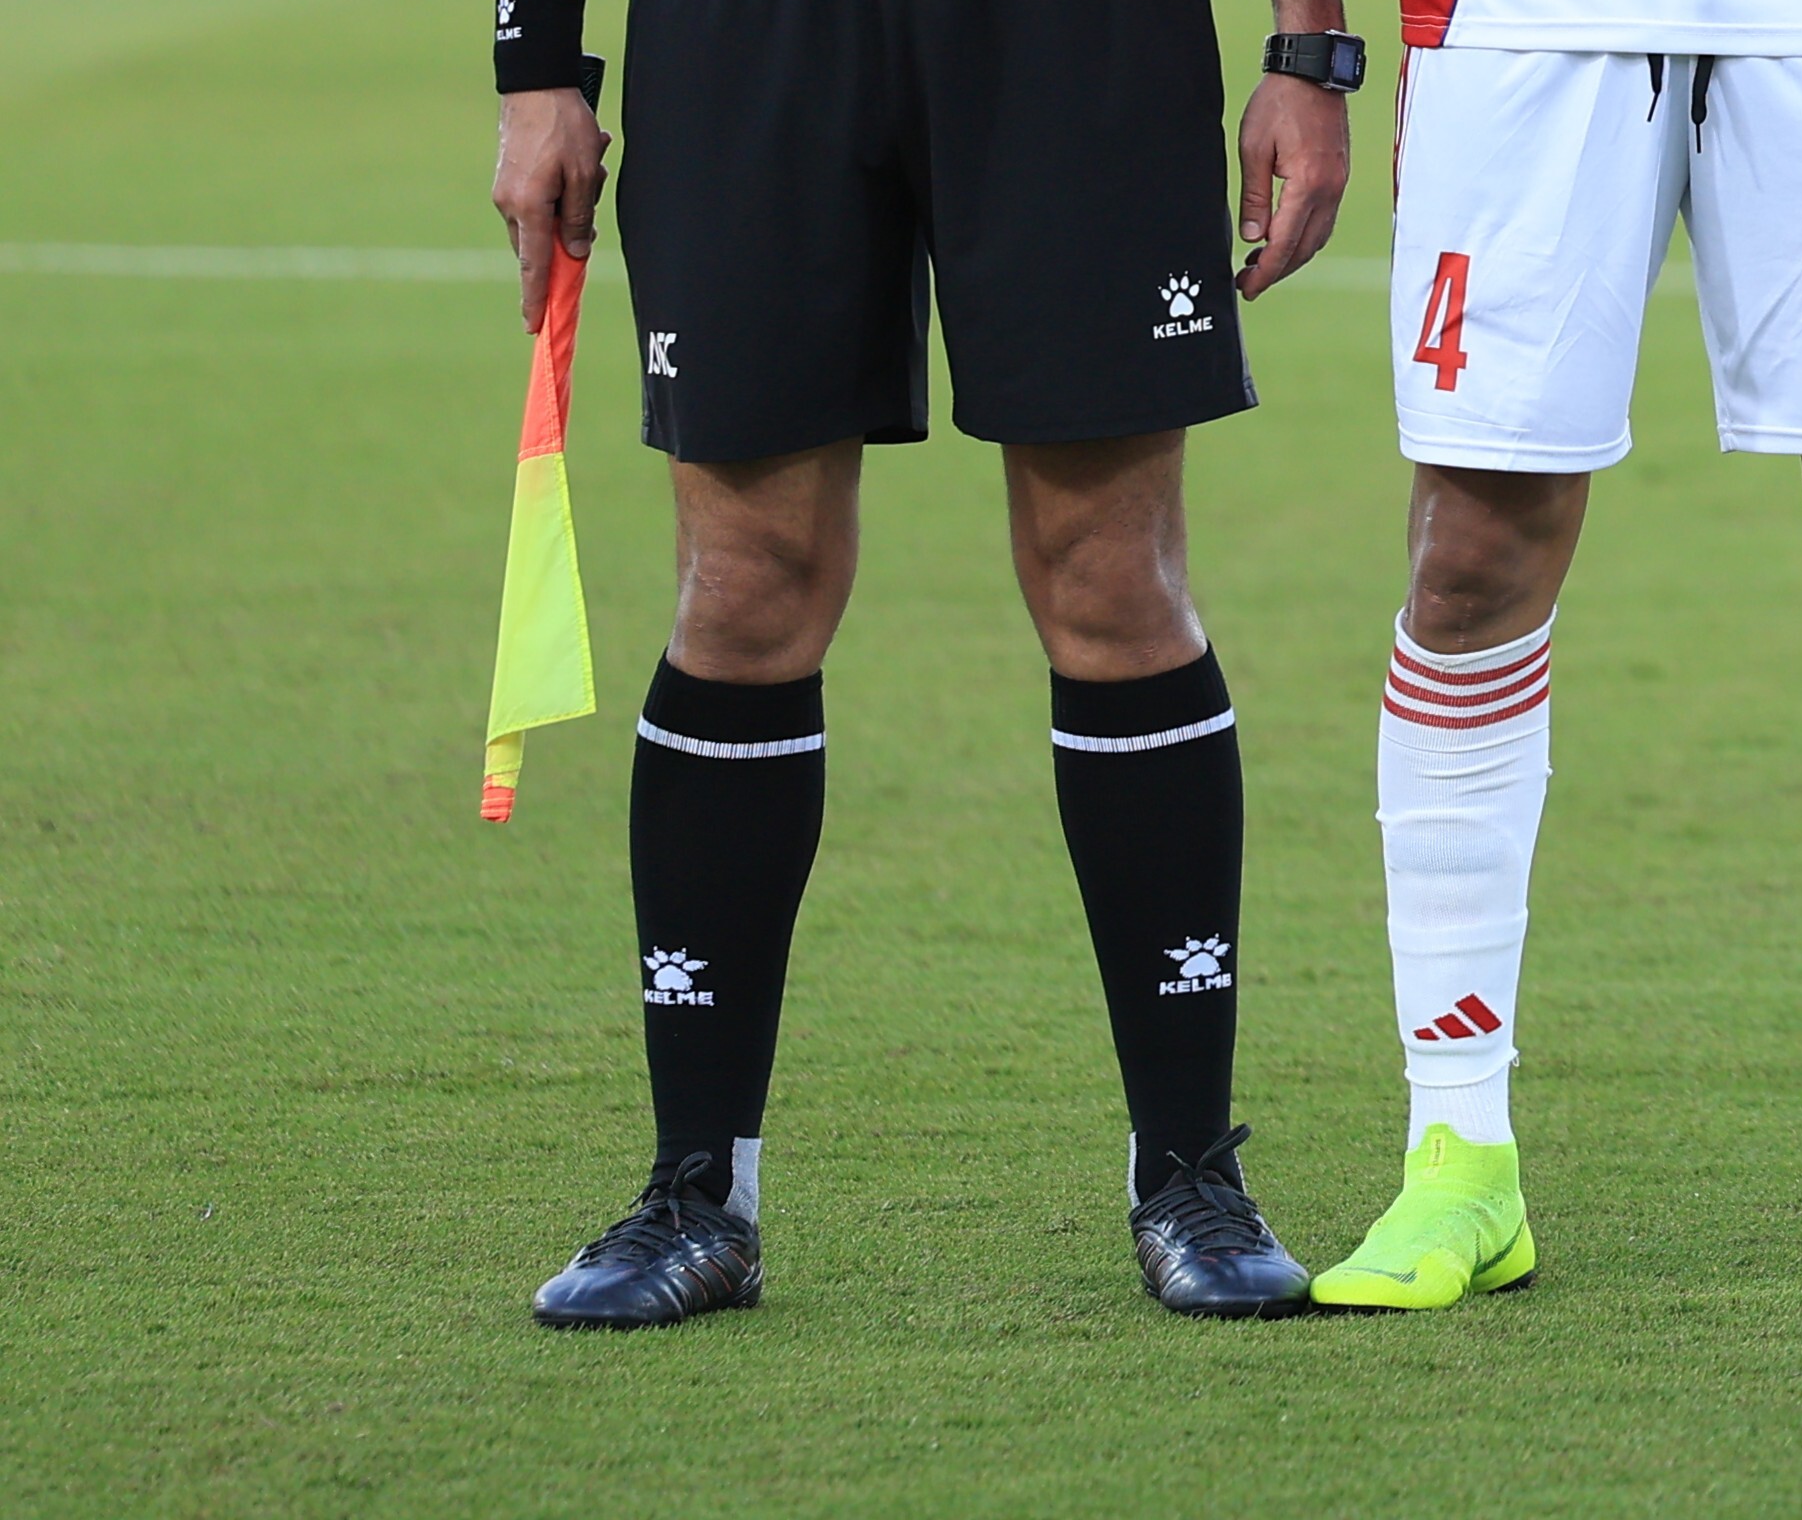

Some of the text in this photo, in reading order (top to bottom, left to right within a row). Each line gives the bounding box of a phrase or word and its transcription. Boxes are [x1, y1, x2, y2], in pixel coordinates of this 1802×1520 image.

[1153, 316, 1213, 340] KELME
[1412, 252, 1471, 392] 4
[1159, 972, 1232, 997] KELME
[643, 988, 714, 1007] KELME
